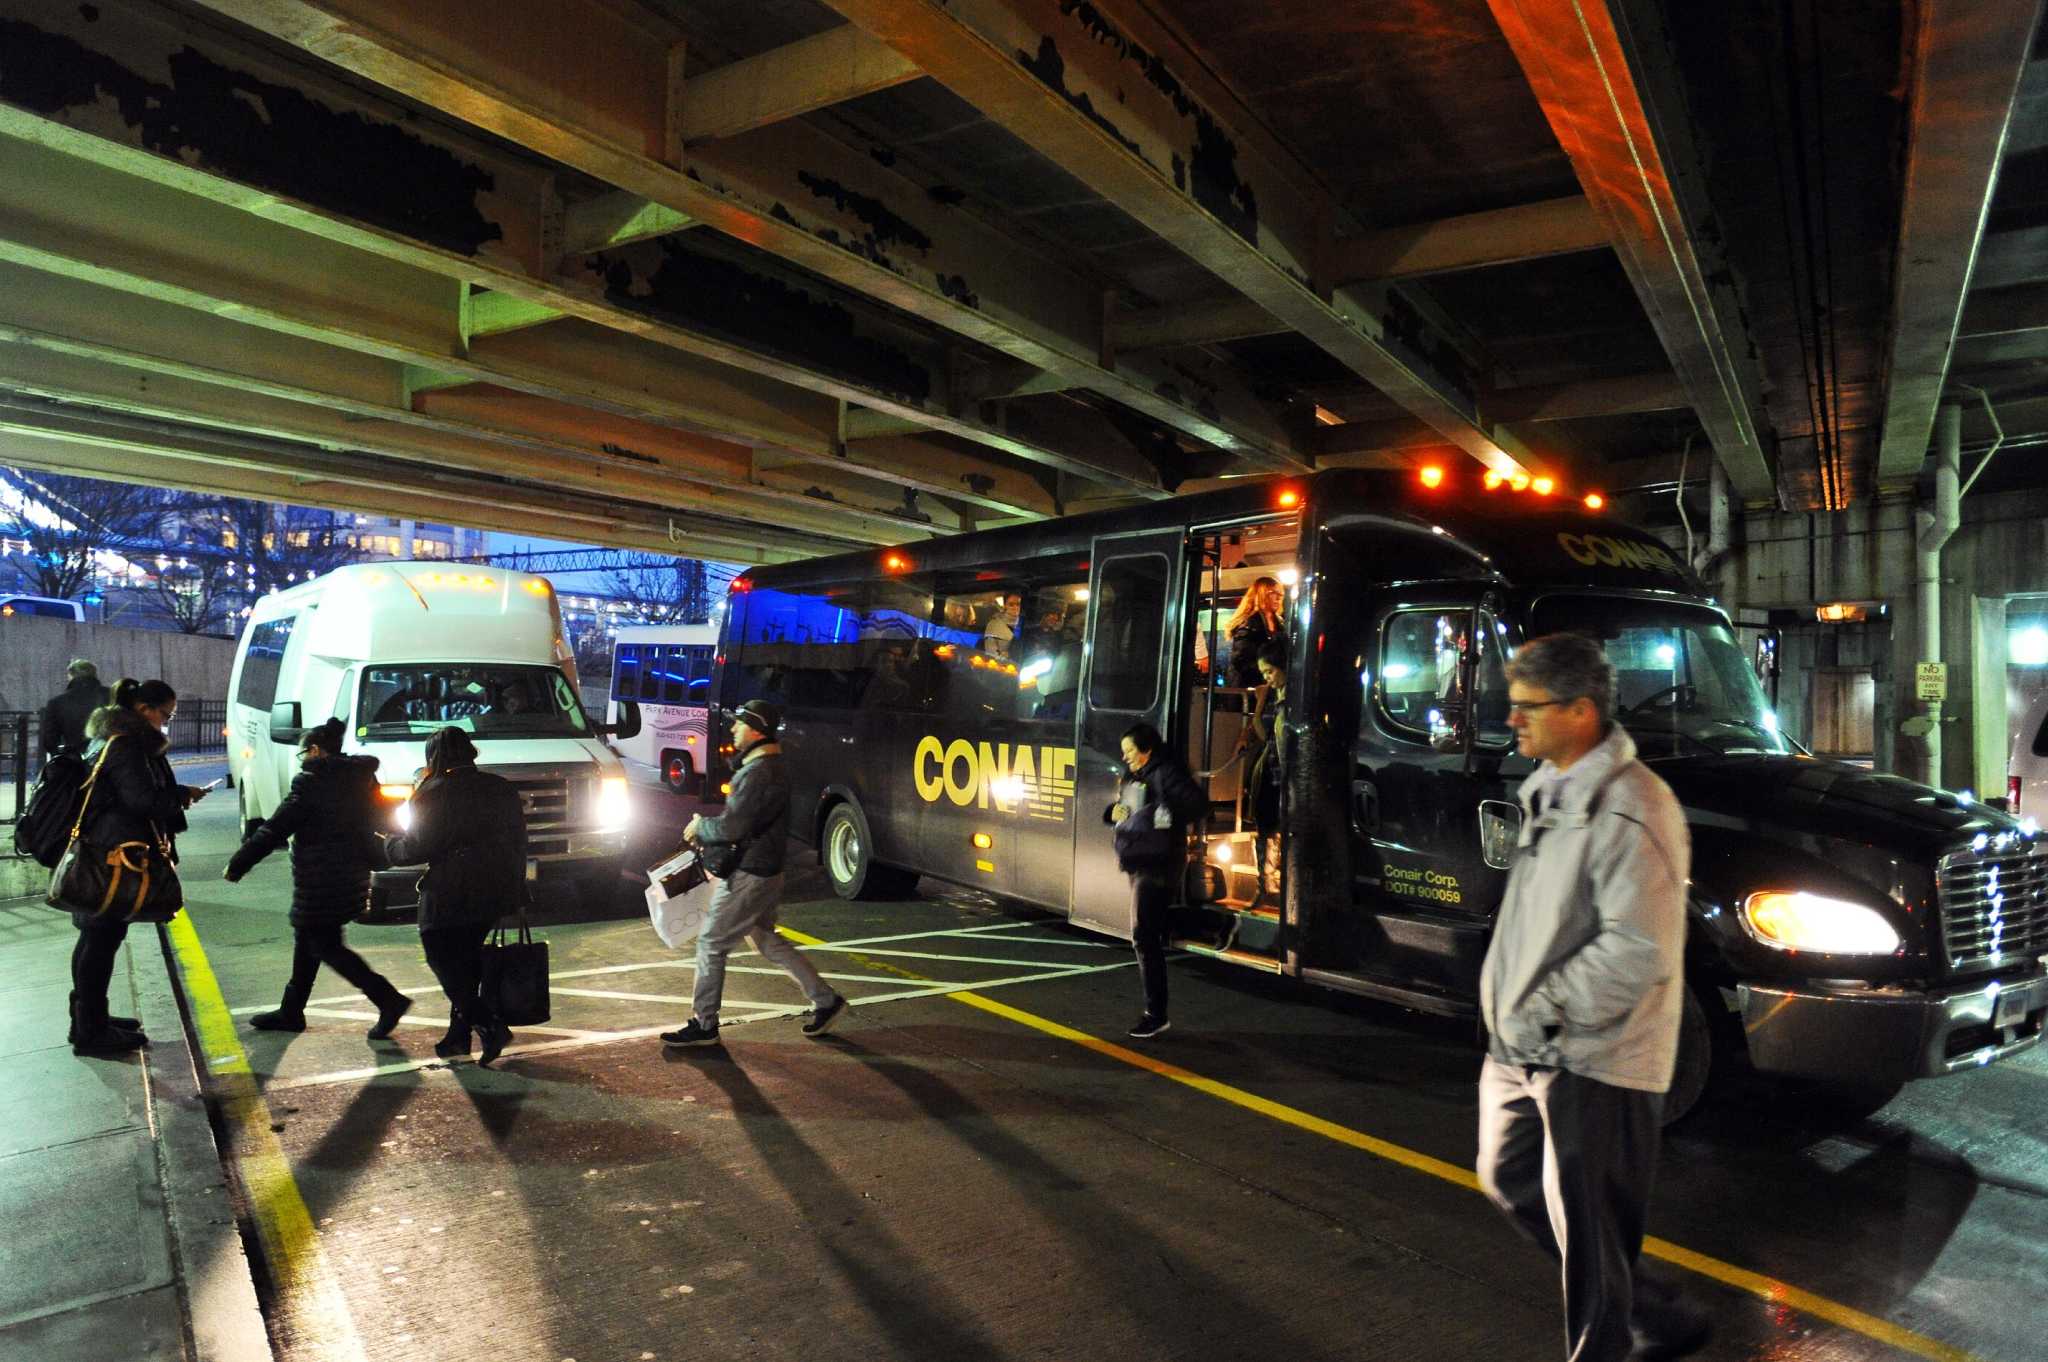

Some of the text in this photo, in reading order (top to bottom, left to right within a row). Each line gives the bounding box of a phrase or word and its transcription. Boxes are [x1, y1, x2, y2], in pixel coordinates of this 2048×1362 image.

[1924, 665, 1939, 673] NO
[1383, 864, 1460, 888] Conair Corp.
[1417, 886, 1461, 903] 900059
